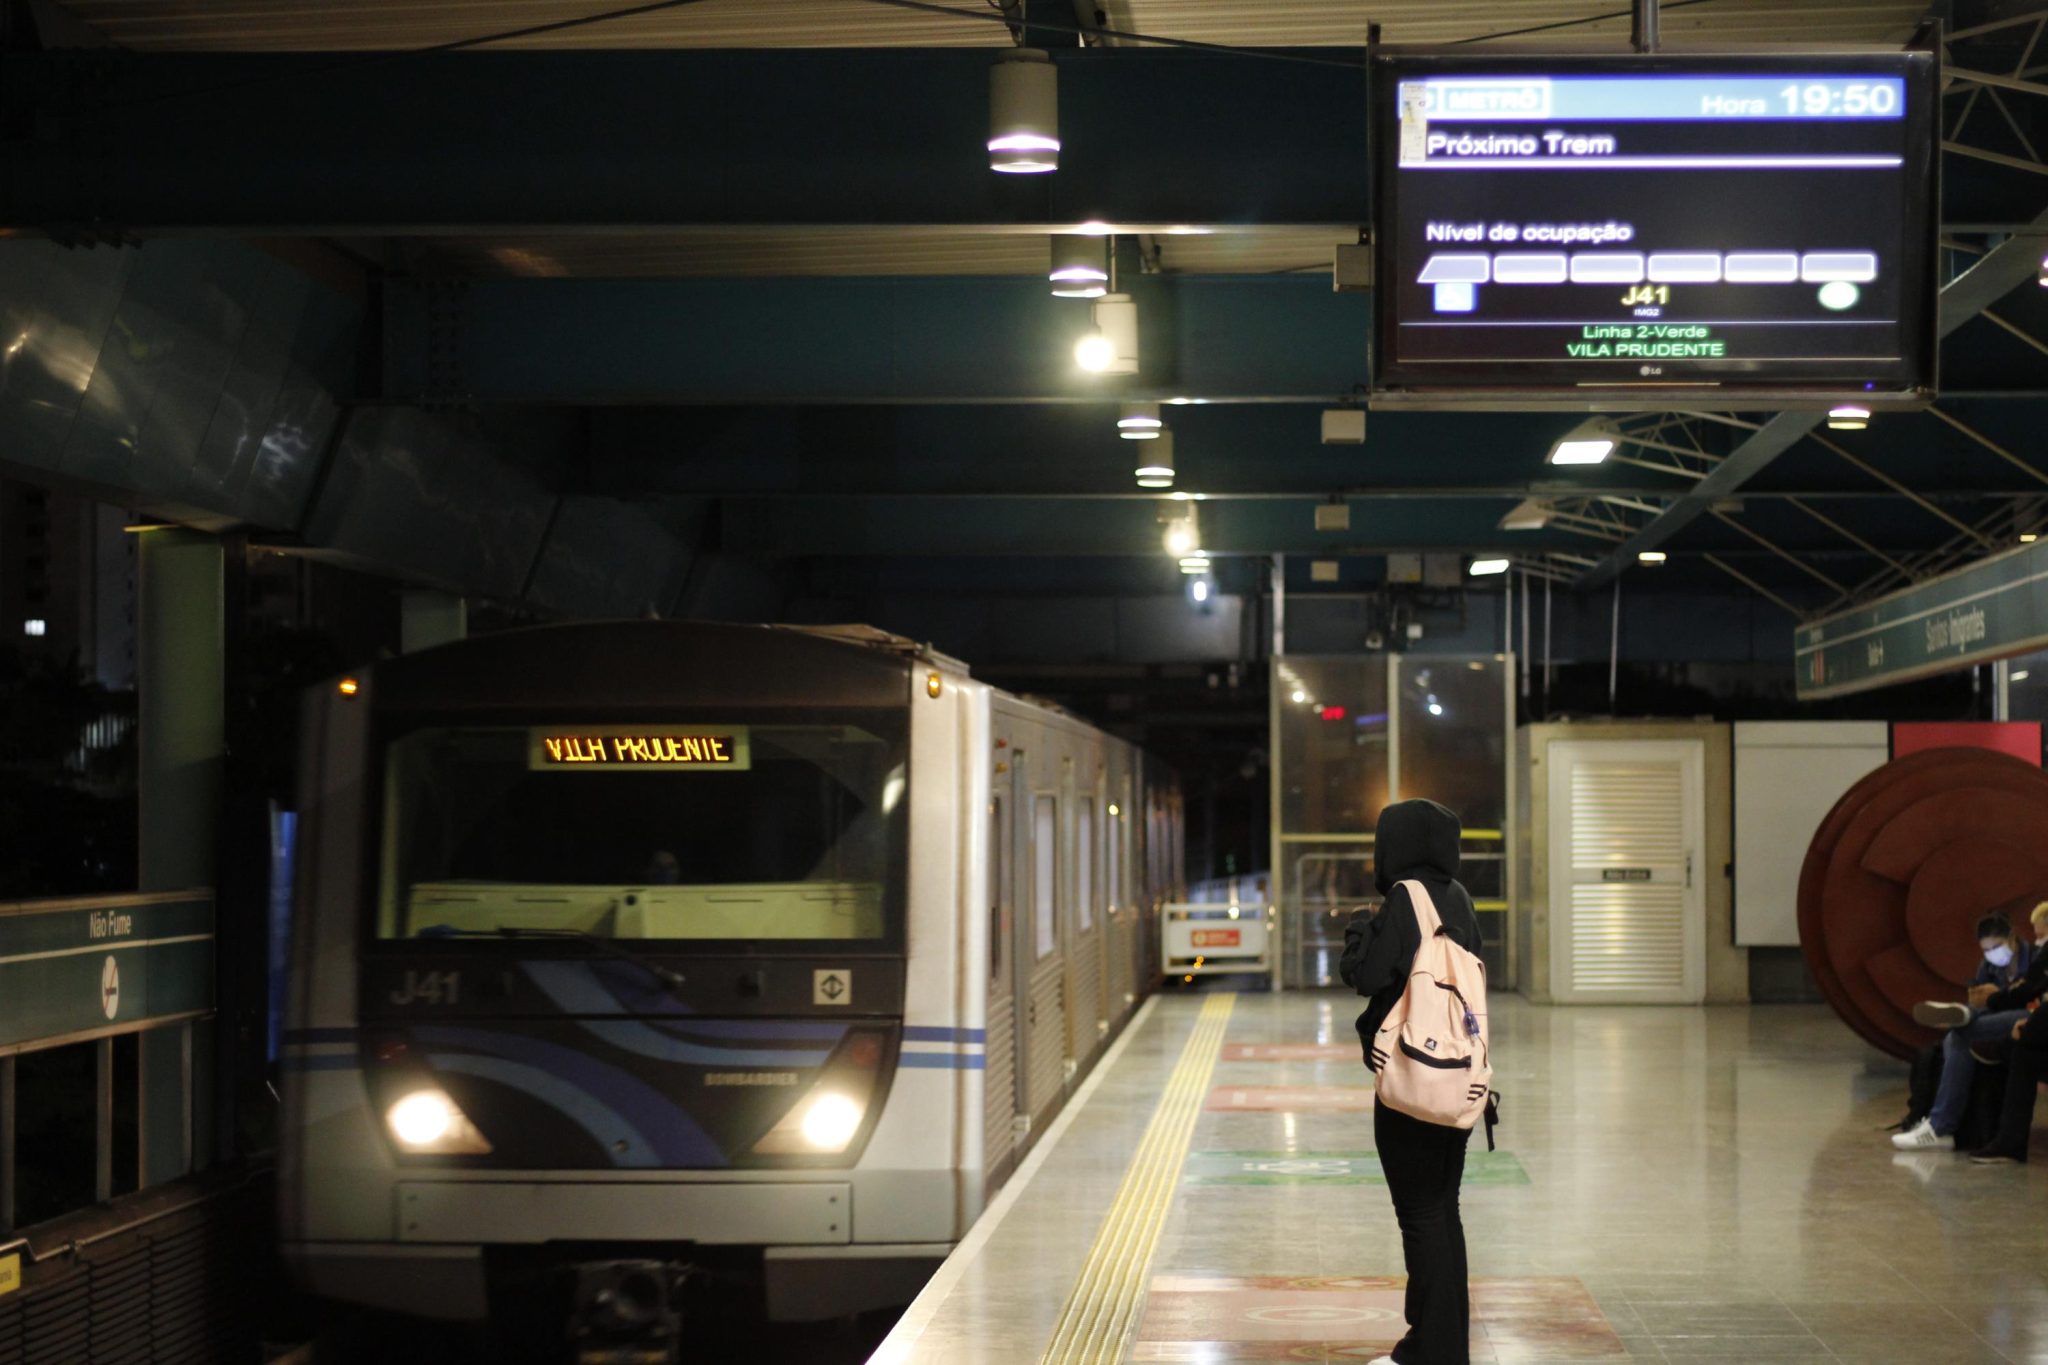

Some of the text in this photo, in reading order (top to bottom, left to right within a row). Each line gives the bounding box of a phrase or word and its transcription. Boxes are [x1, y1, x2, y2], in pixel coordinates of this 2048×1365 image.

[1448, 87, 1538, 110] METRÔ
[1701, 84, 1895, 114] Hora 19:50
[1427, 131, 1615, 155] Próximo Trem
[1426, 222, 1634, 244] Nível de ocupação
[1620, 285, 1670, 306] J41
[1633, 308, 1660, 317] IMG2
[1583, 325, 1707, 339] Linha 2-Verde
[1567, 343, 1725, 357] VILA PRUDENTE
[90, 910, 131, 938] Não Fume
[389, 970, 460, 1005] J41
